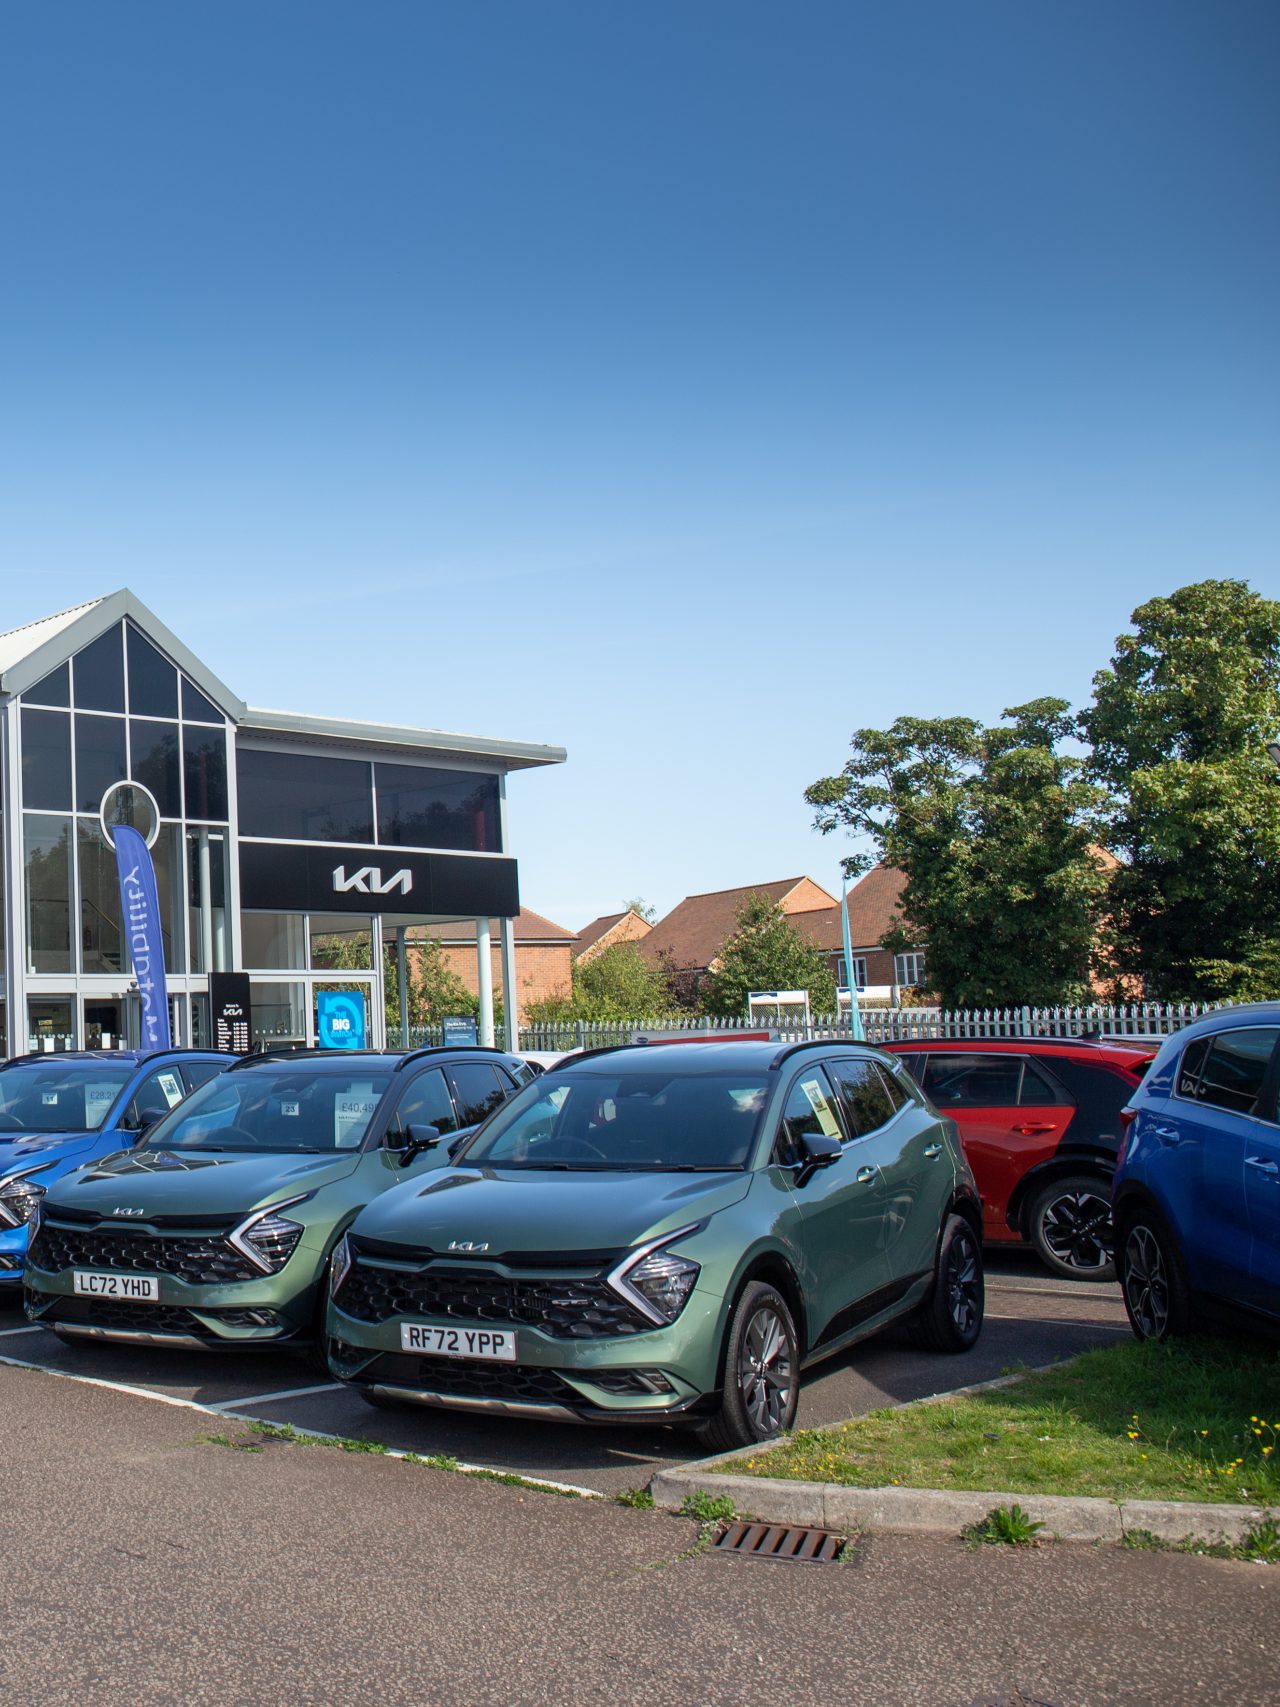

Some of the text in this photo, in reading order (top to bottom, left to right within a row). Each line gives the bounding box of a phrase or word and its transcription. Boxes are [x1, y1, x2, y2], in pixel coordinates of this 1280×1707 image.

[332, 865, 413, 896] KIA
[334, 1011, 347, 1019] THE
[332, 1018, 351, 1031] BIG
[285, 1105, 296, 1113] 23
[448, 1240, 489, 1251] KIA
[80, 1274, 151, 1297] LC72 YHD
[409, 1326, 505, 1355] RF72 YPP
